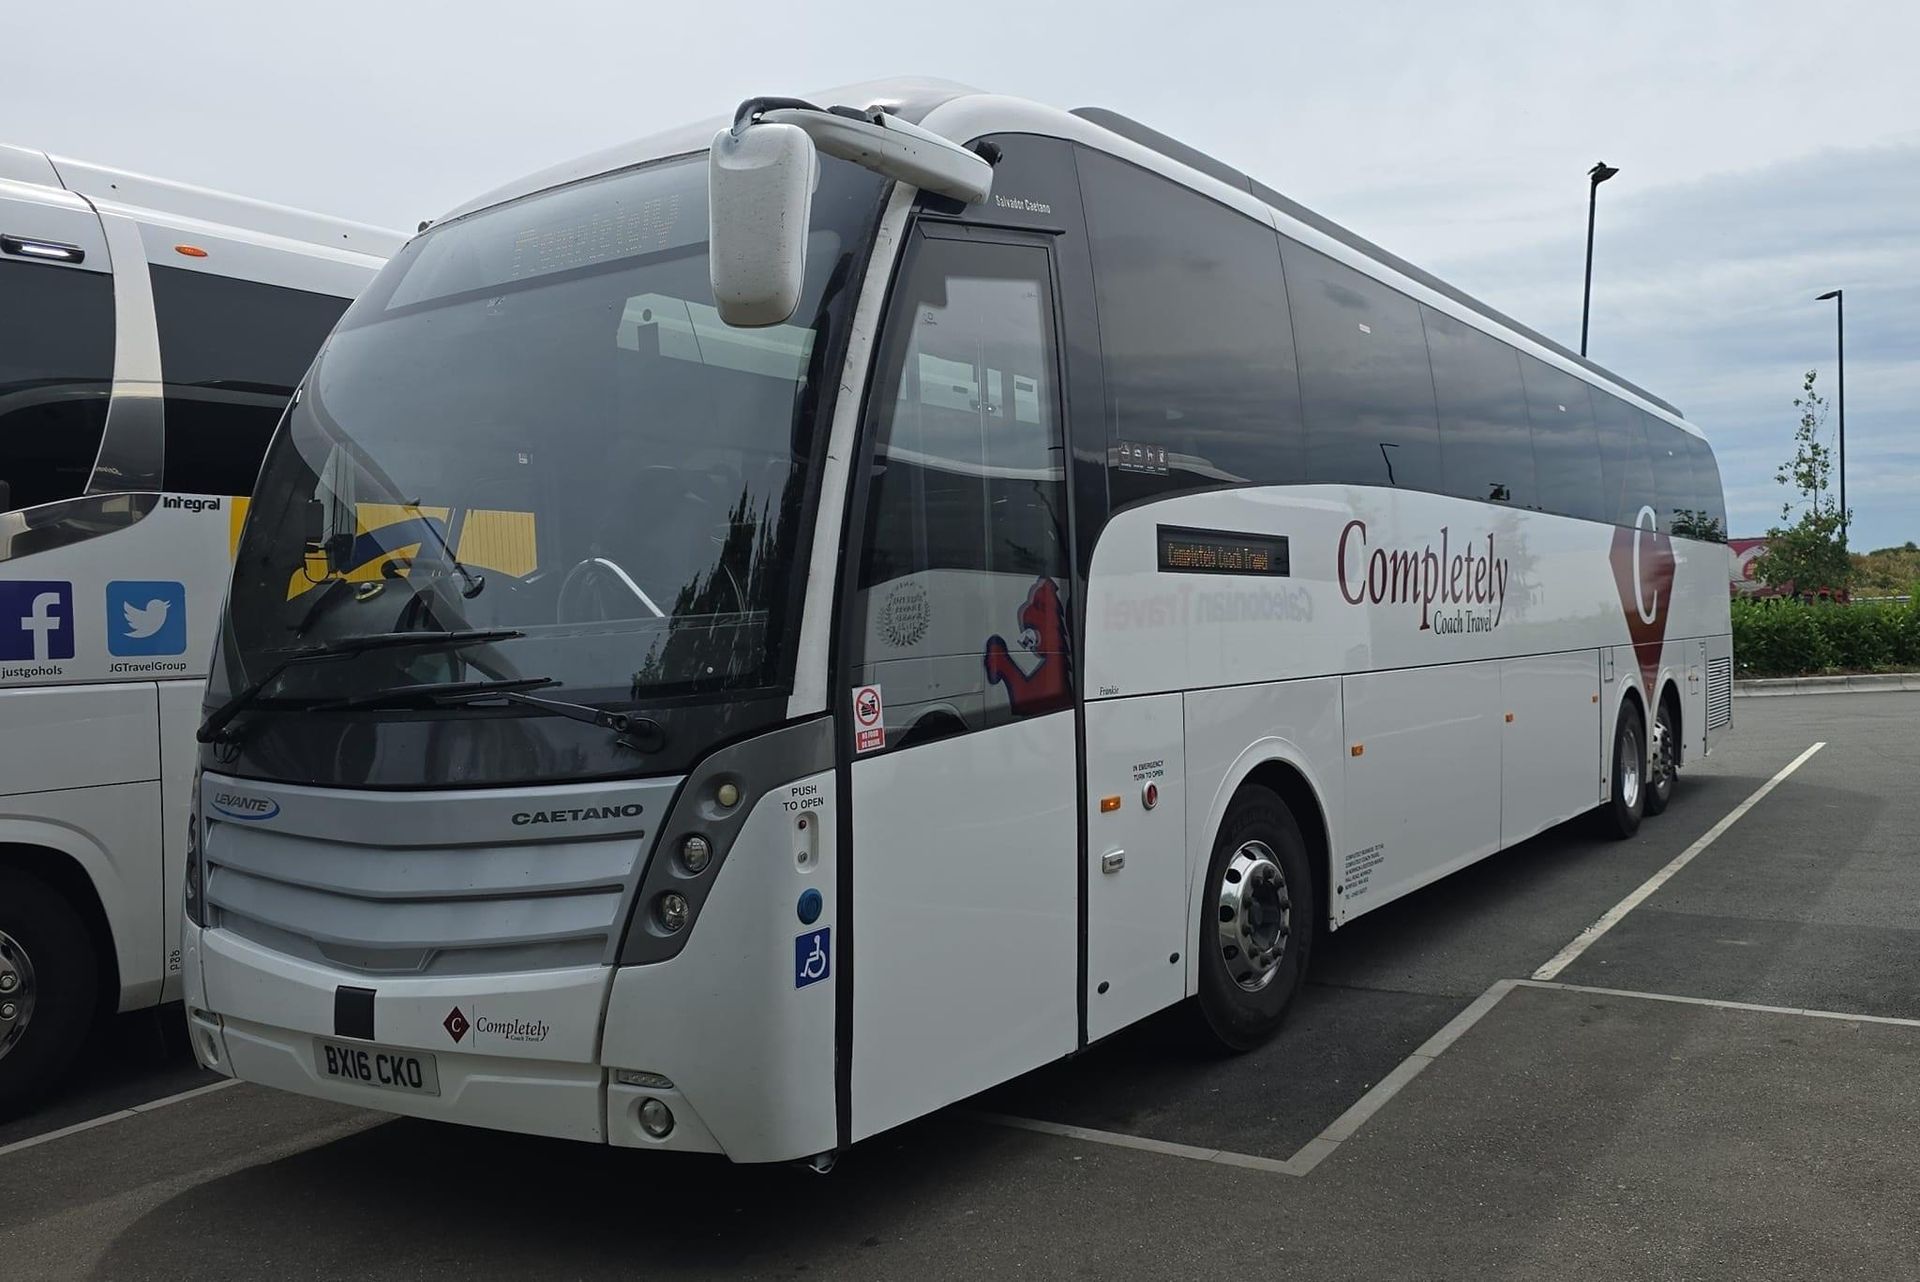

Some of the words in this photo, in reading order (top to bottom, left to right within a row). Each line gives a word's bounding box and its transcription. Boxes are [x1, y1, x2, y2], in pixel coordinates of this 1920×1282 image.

[995, 194, 1024, 209] Salvador
[1025, 199, 1051, 214] Caetano
[163, 496, 220, 513] Integral
[1337, 519, 1508, 630] Completely
[1434, 609, 1463, 635] Coach
[1465, 609, 1492, 633] Travel
[2, 665, 63, 679] justgohols
[109, 661, 187, 673] JGTravelGroup
[791, 785, 817, 797] PUSH
[215, 793, 269, 812] LEVANTE
[783, 801, 798, 812] TO
[801, 797, 824, 809] OPEN
[511, 804, 643, 825] CAETANO
[451, 1017, 462, 1032] C
[476, 1016, 550, 1042] Completely
[324, 1045, 372, 1081] BX16
[376, 1054, 423, 1089] CKO
